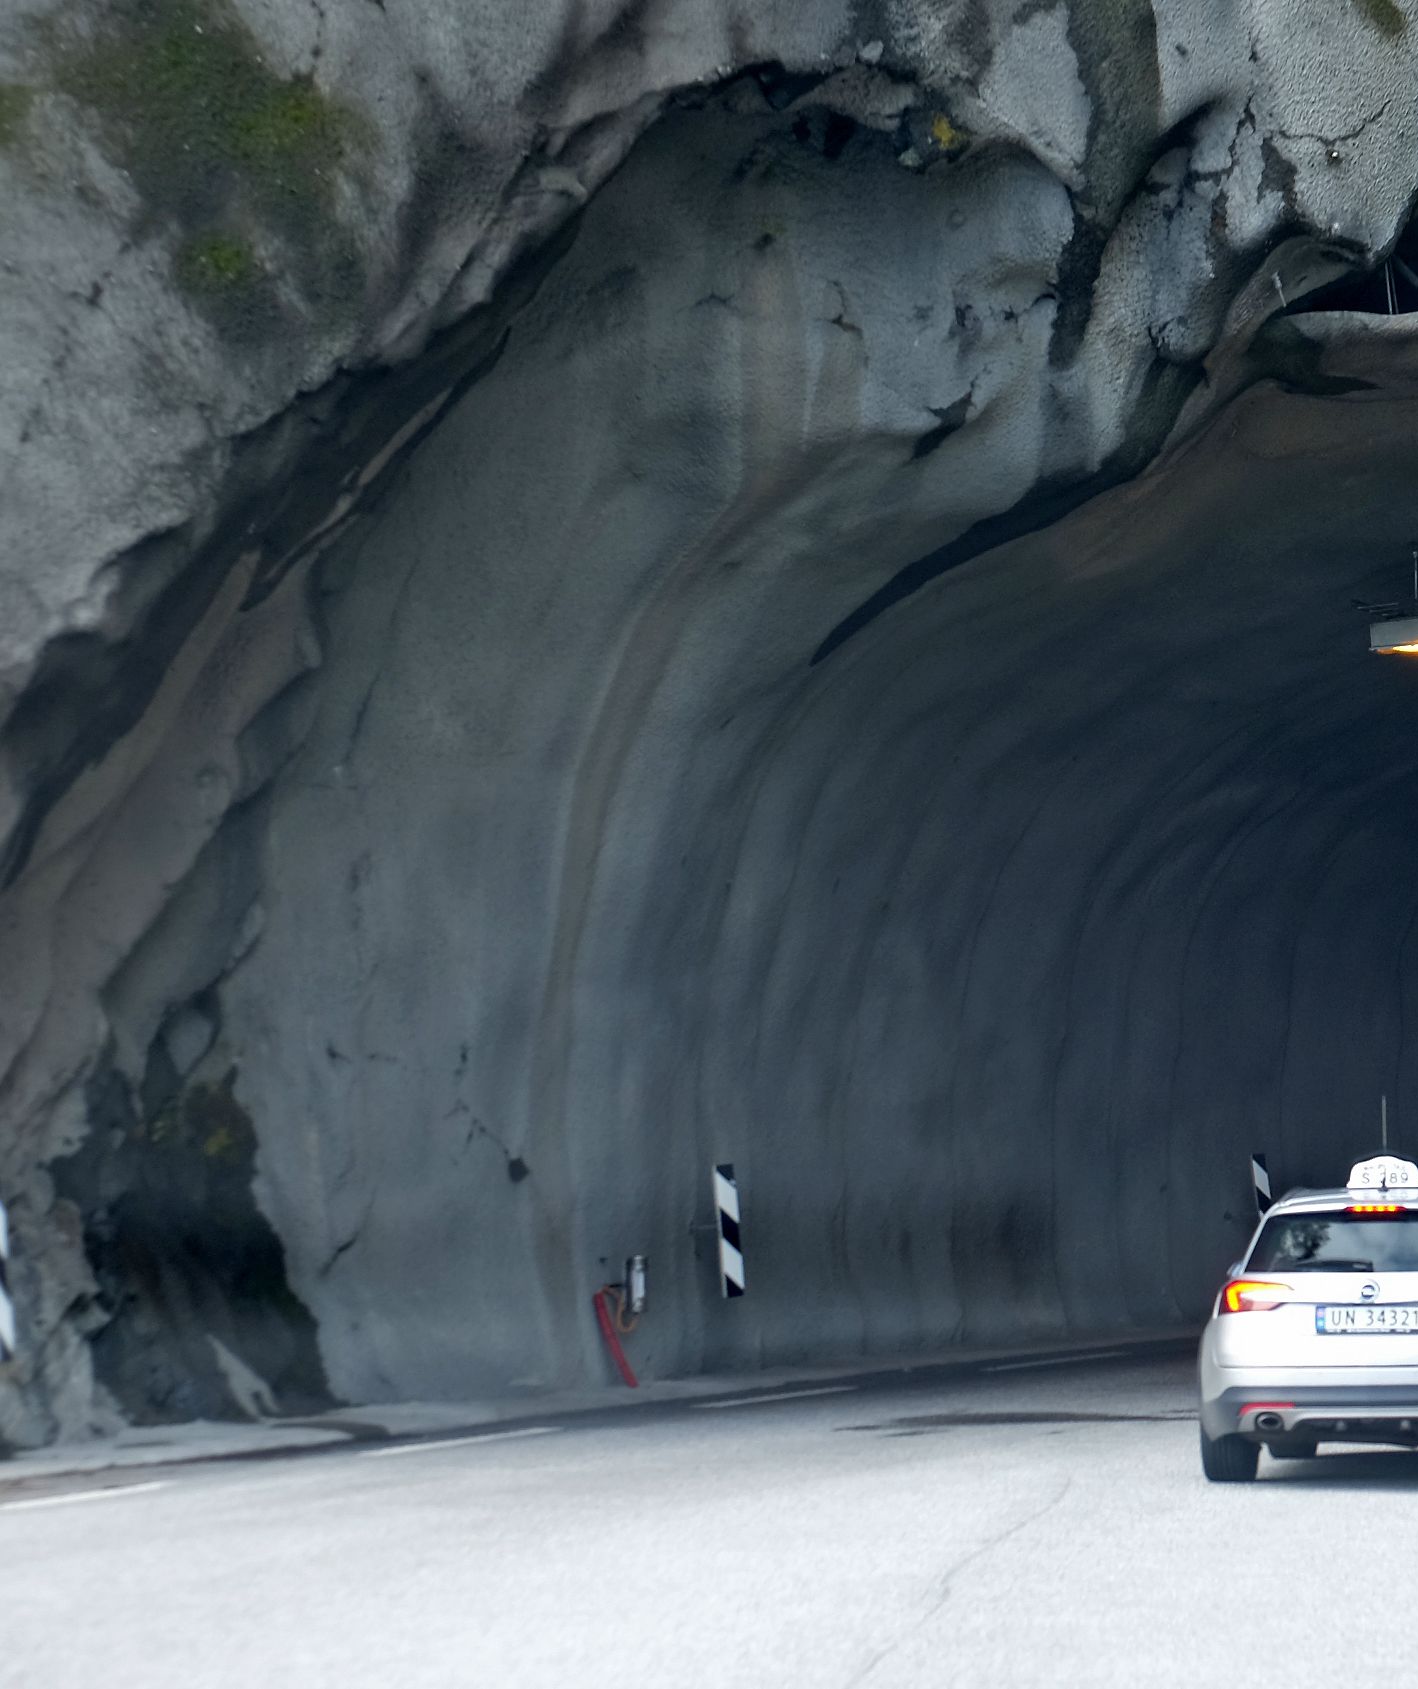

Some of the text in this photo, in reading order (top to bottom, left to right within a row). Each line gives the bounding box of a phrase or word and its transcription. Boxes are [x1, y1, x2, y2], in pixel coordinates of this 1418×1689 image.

[1361, 1172, 1370, 1184] S
[1331, 1309, 1418, 1326] UN 34321
